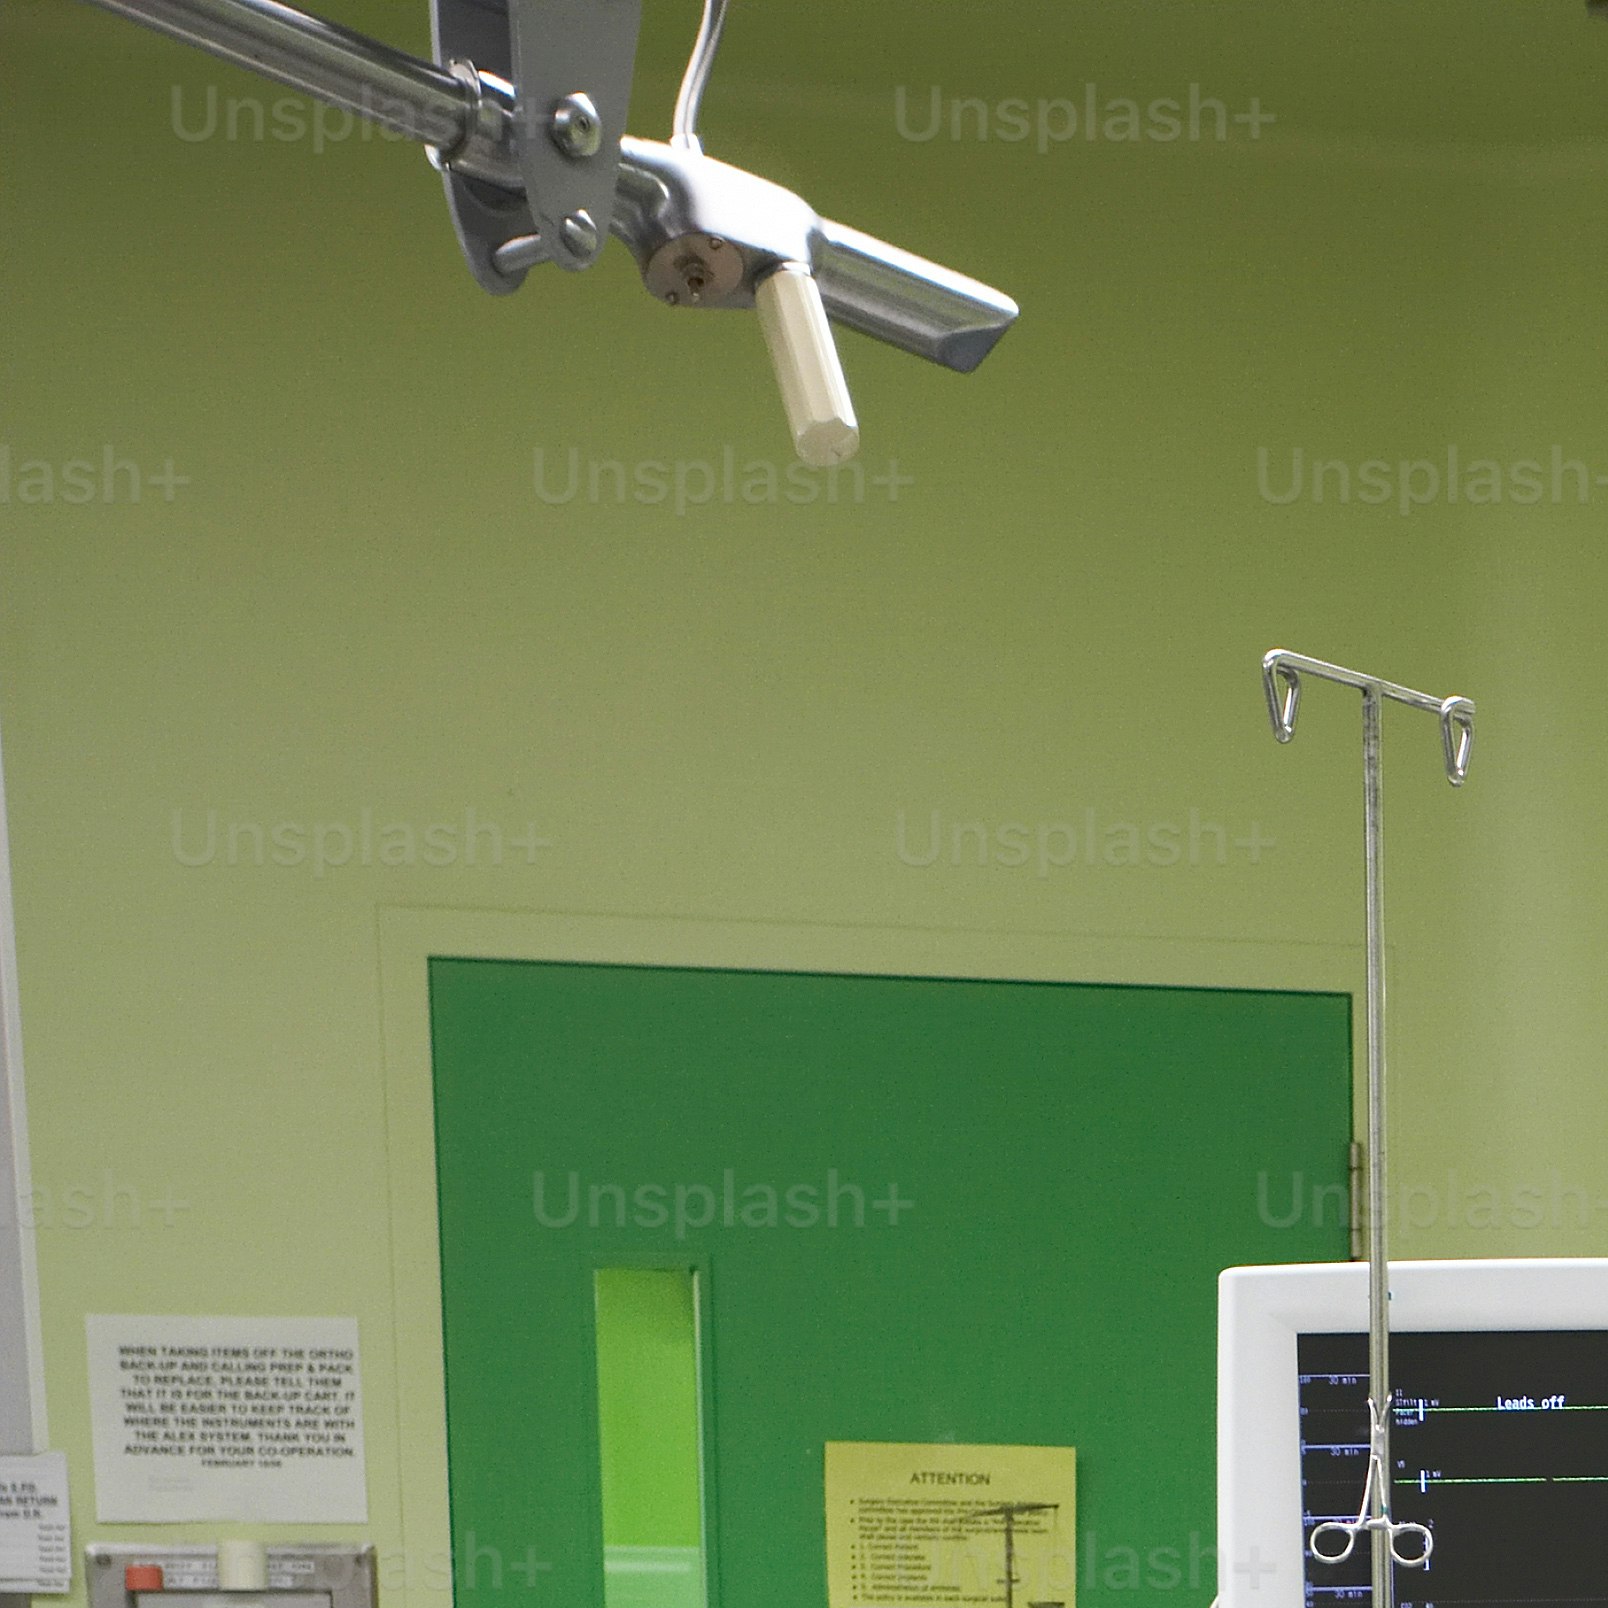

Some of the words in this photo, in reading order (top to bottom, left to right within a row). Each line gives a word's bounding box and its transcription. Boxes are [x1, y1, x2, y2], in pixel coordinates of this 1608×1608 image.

[119, 1346, 157, 1356] WHEN
[162, 1347, 208, 1357] TAKING
[212, 1347, 249, 1357] ITEMS
[283, 1349, 304, 1358] THE
[181, 1362, 207, 1371] AND
[211, 1362, 265, 1372] CALLING
[319, 1364, 352, 1374] PACK
[133, 1375, 150, 1384] TO
[220, 1376, 268, 1386] PLEASE
[274, 1377, 302, 1387] TELL
[308, 1377, 341, 1387] THEM
[122, 1389, 151, 1398] THAT
[186, 1390, 211, 1400] FOR
[217, 1390, 239, 1400] THE
[1497, 1396, 1534, 1410] Leads
[1542, 1395, 1565, 1410] off
[126, 1403, 154, 1412] WILL
[161, 1403, 176, 1413] BE
[231, 1404, 247, 1414] TO
[251, 1404, 284, 1414] KEEP
[288, 1405, 330, 1415] TRACK
[124, 1417, 169, 1427] WHERE
[174, 1418, 197, 1427] THE
[295, 1419, 319, 1429] ARE
[324, 1420, 355, 1429] WITH
[135, 1431, 157, 1441] THE
[258, 1433, 299, 1442] THANK
[305, 1433, 329, 1443] YOU
[189, 1446, 215, 1455] FOR
[910, 1473, 990, 1485] ATTENTION
